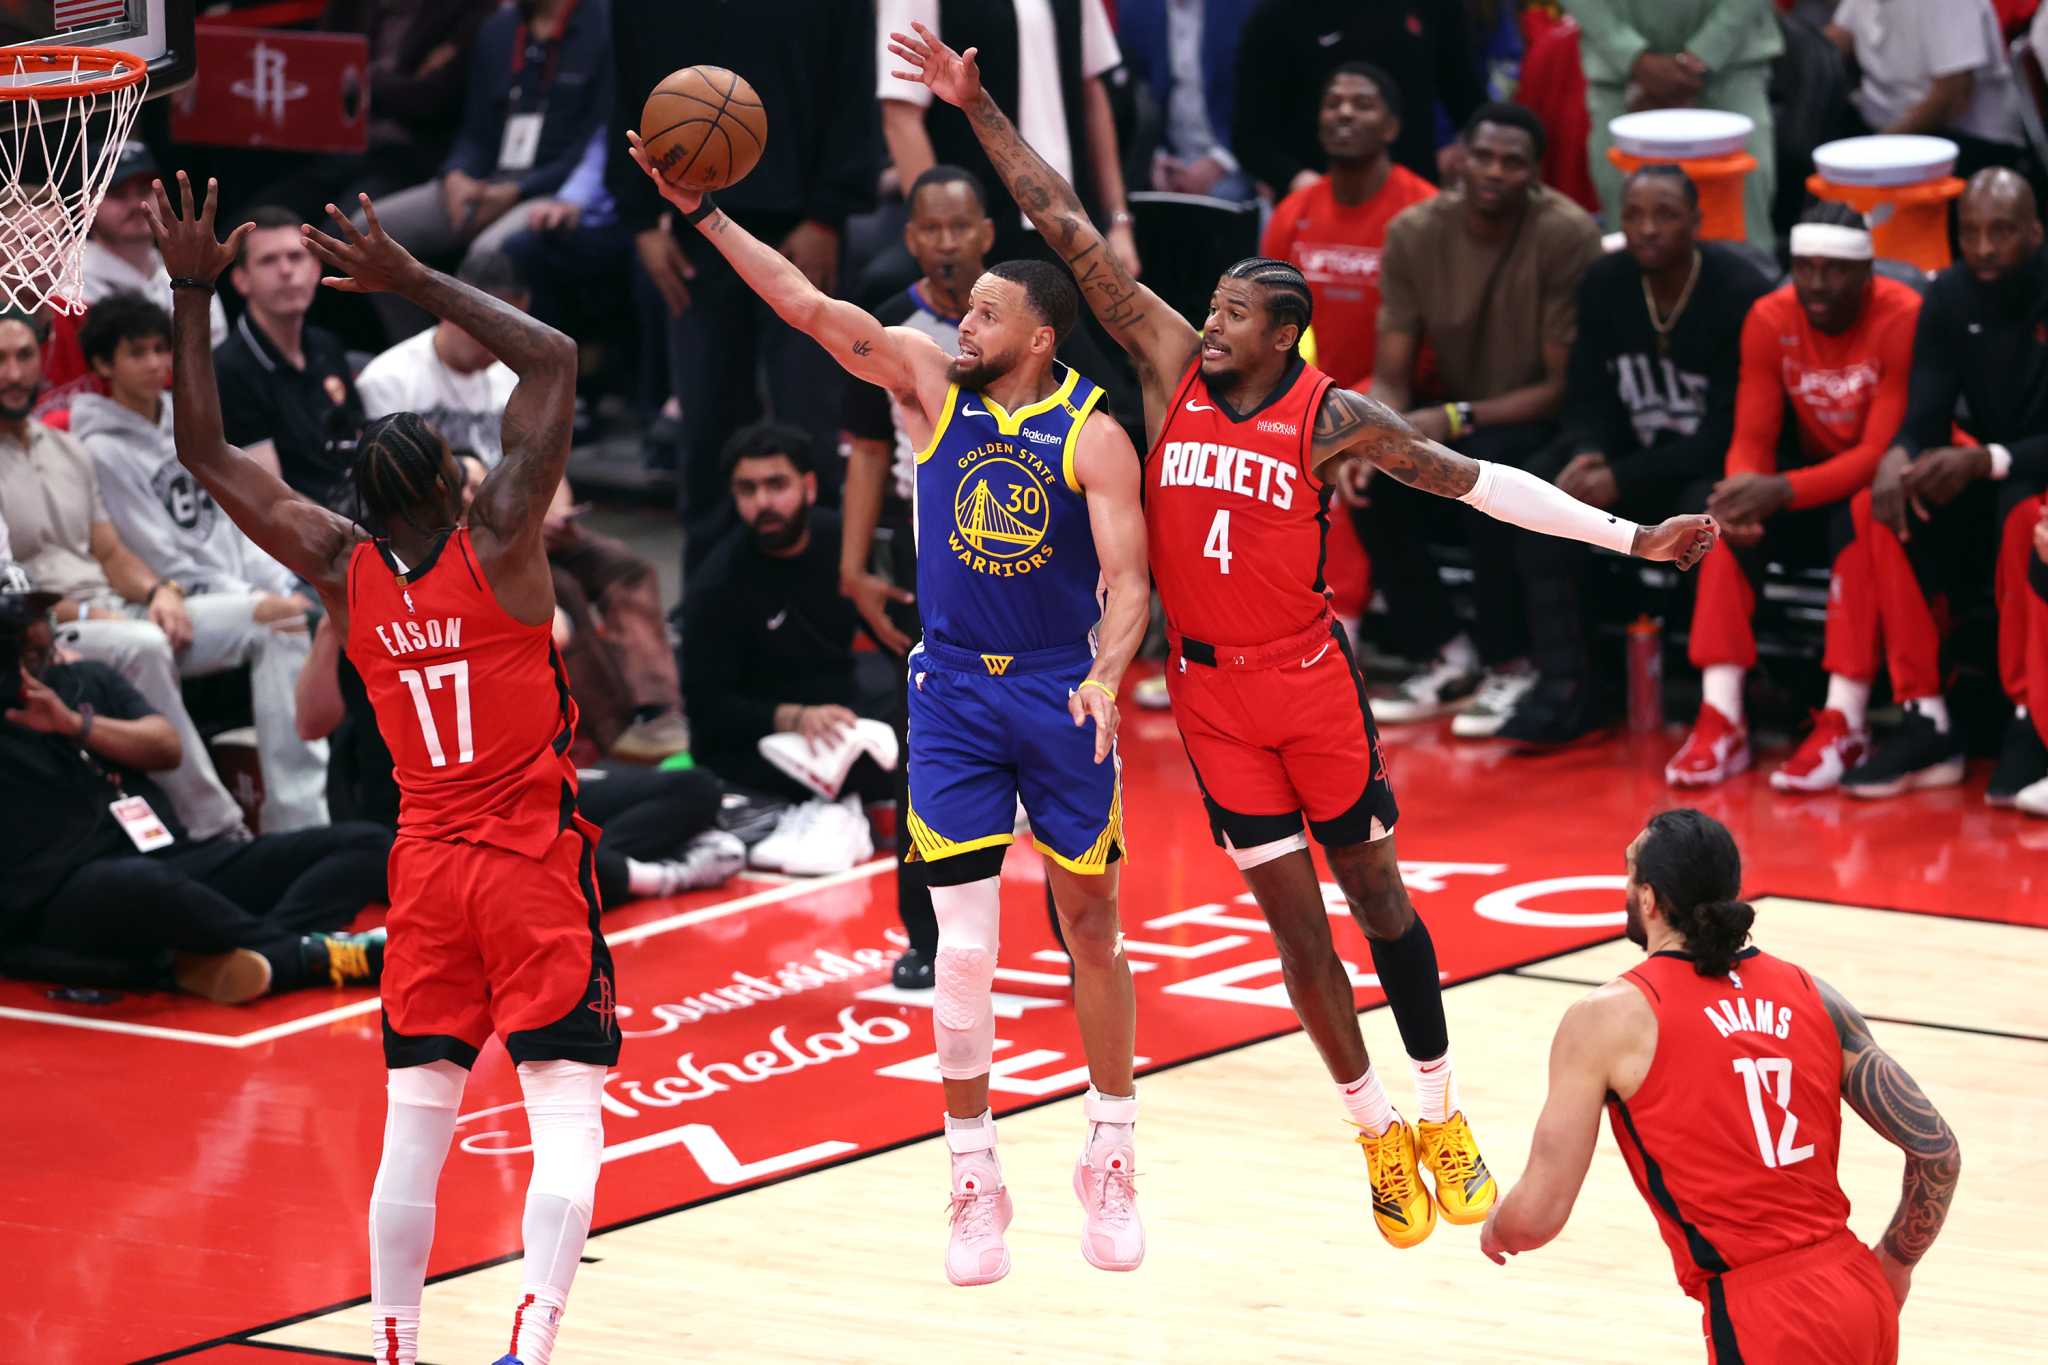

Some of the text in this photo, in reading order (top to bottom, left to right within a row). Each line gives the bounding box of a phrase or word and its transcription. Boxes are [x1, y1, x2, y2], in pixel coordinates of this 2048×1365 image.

[1022, 427, 1062, 445] Rakuten
[957, 443, 1056, 485] GOLDEN STATE
[1160, 441, 1297, 511] ROCKETS
[1005, 483, 1040, 515] 30
[948, 530, 1054, 577] WARRIORS
[1203, 509, 1233, 575] 4
[376, 617, 462, 656] EASON
[398, 659, 474, 767] 17
[1704, 997, 1792, 1040] ADAMS
[1732, 1057, 1815, 1169] 12
